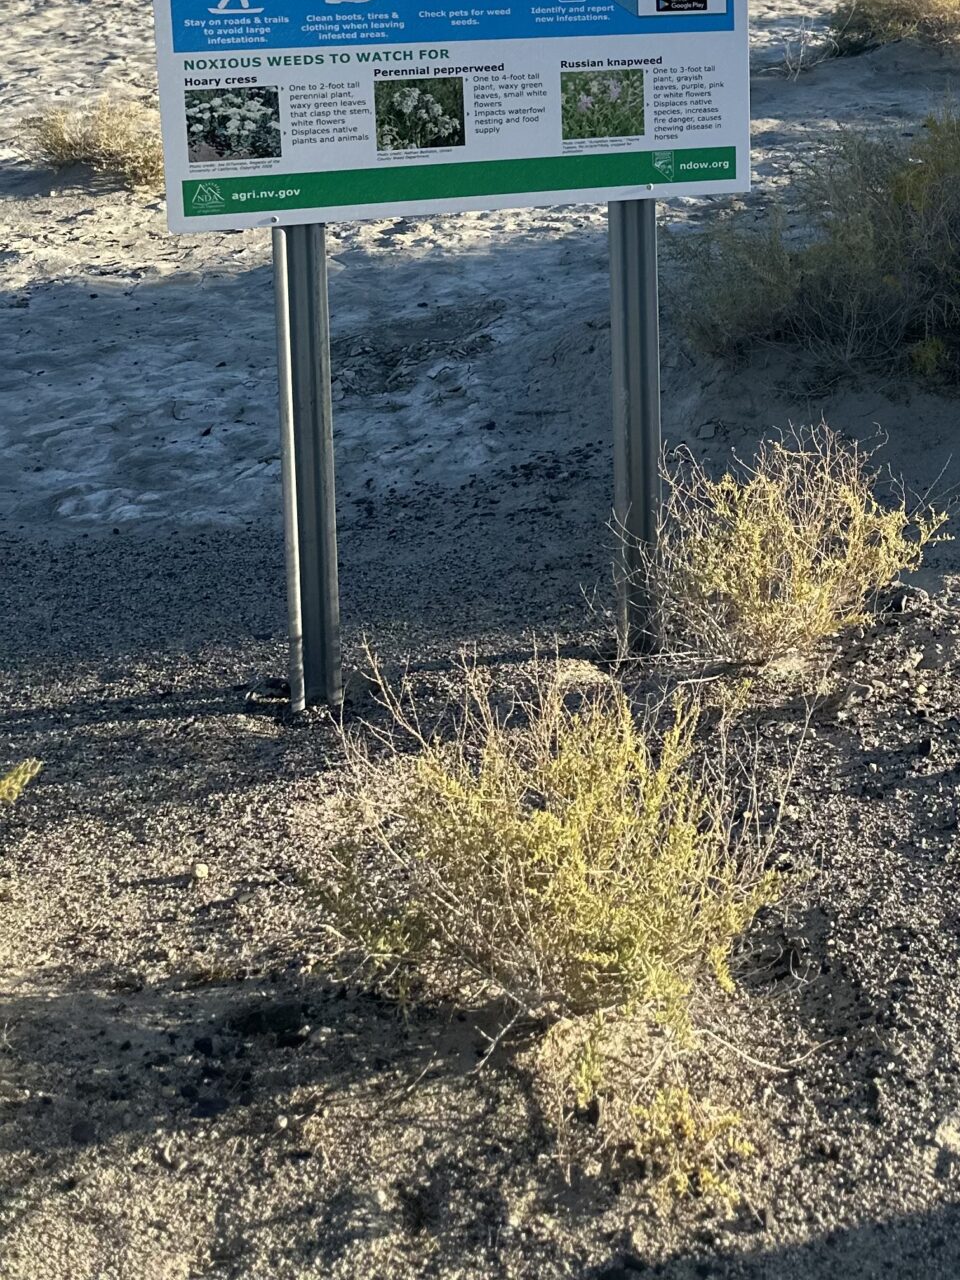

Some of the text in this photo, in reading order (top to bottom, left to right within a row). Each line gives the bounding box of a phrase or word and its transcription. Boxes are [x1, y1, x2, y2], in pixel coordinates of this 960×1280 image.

[419, 10, 446, 18] Check
[449, 10, 468, 18] pets
[531, 5, 615, 15] Identify and report
[184, 19, 206, 27] Stay
[224, 17, 251, 25] roads
[306, 14, 332, 22] Clean
[335, 13, 365, 22] boots,
[451, 18, 479, 26] seeds.
[556, 14, 610, 22] infestations.
[246, 26, 271, 34] large
[301, 21, 404, 32] clothing when leaving
[208, 36, 268, 45] infestations.
[319, 32, 358, 40] infested
[184, 49, 449, 70] NOXIOUS WEEDS TO WATCH FOR
[561, 56, 662, 68] Russian knapweed
[374, 63, 504, 77] Perennial pepperweed
[184, 76, 257, 86] Hoary cress
[290, 91, 353, 101] perennial plant,
[314, 101, 337, 109] green
[654, 100, 687, 108] Displaces
[475, 107, 545, 117] Impacts waterfowl
[292, 128, 330, 136] Displaces
[292, 137, 317, 145] plants
[338, 134, 369, 142] animals
[680, 160, 729, 170] ndow.org
[232, 188, 300, 200] agri.nv.gov
